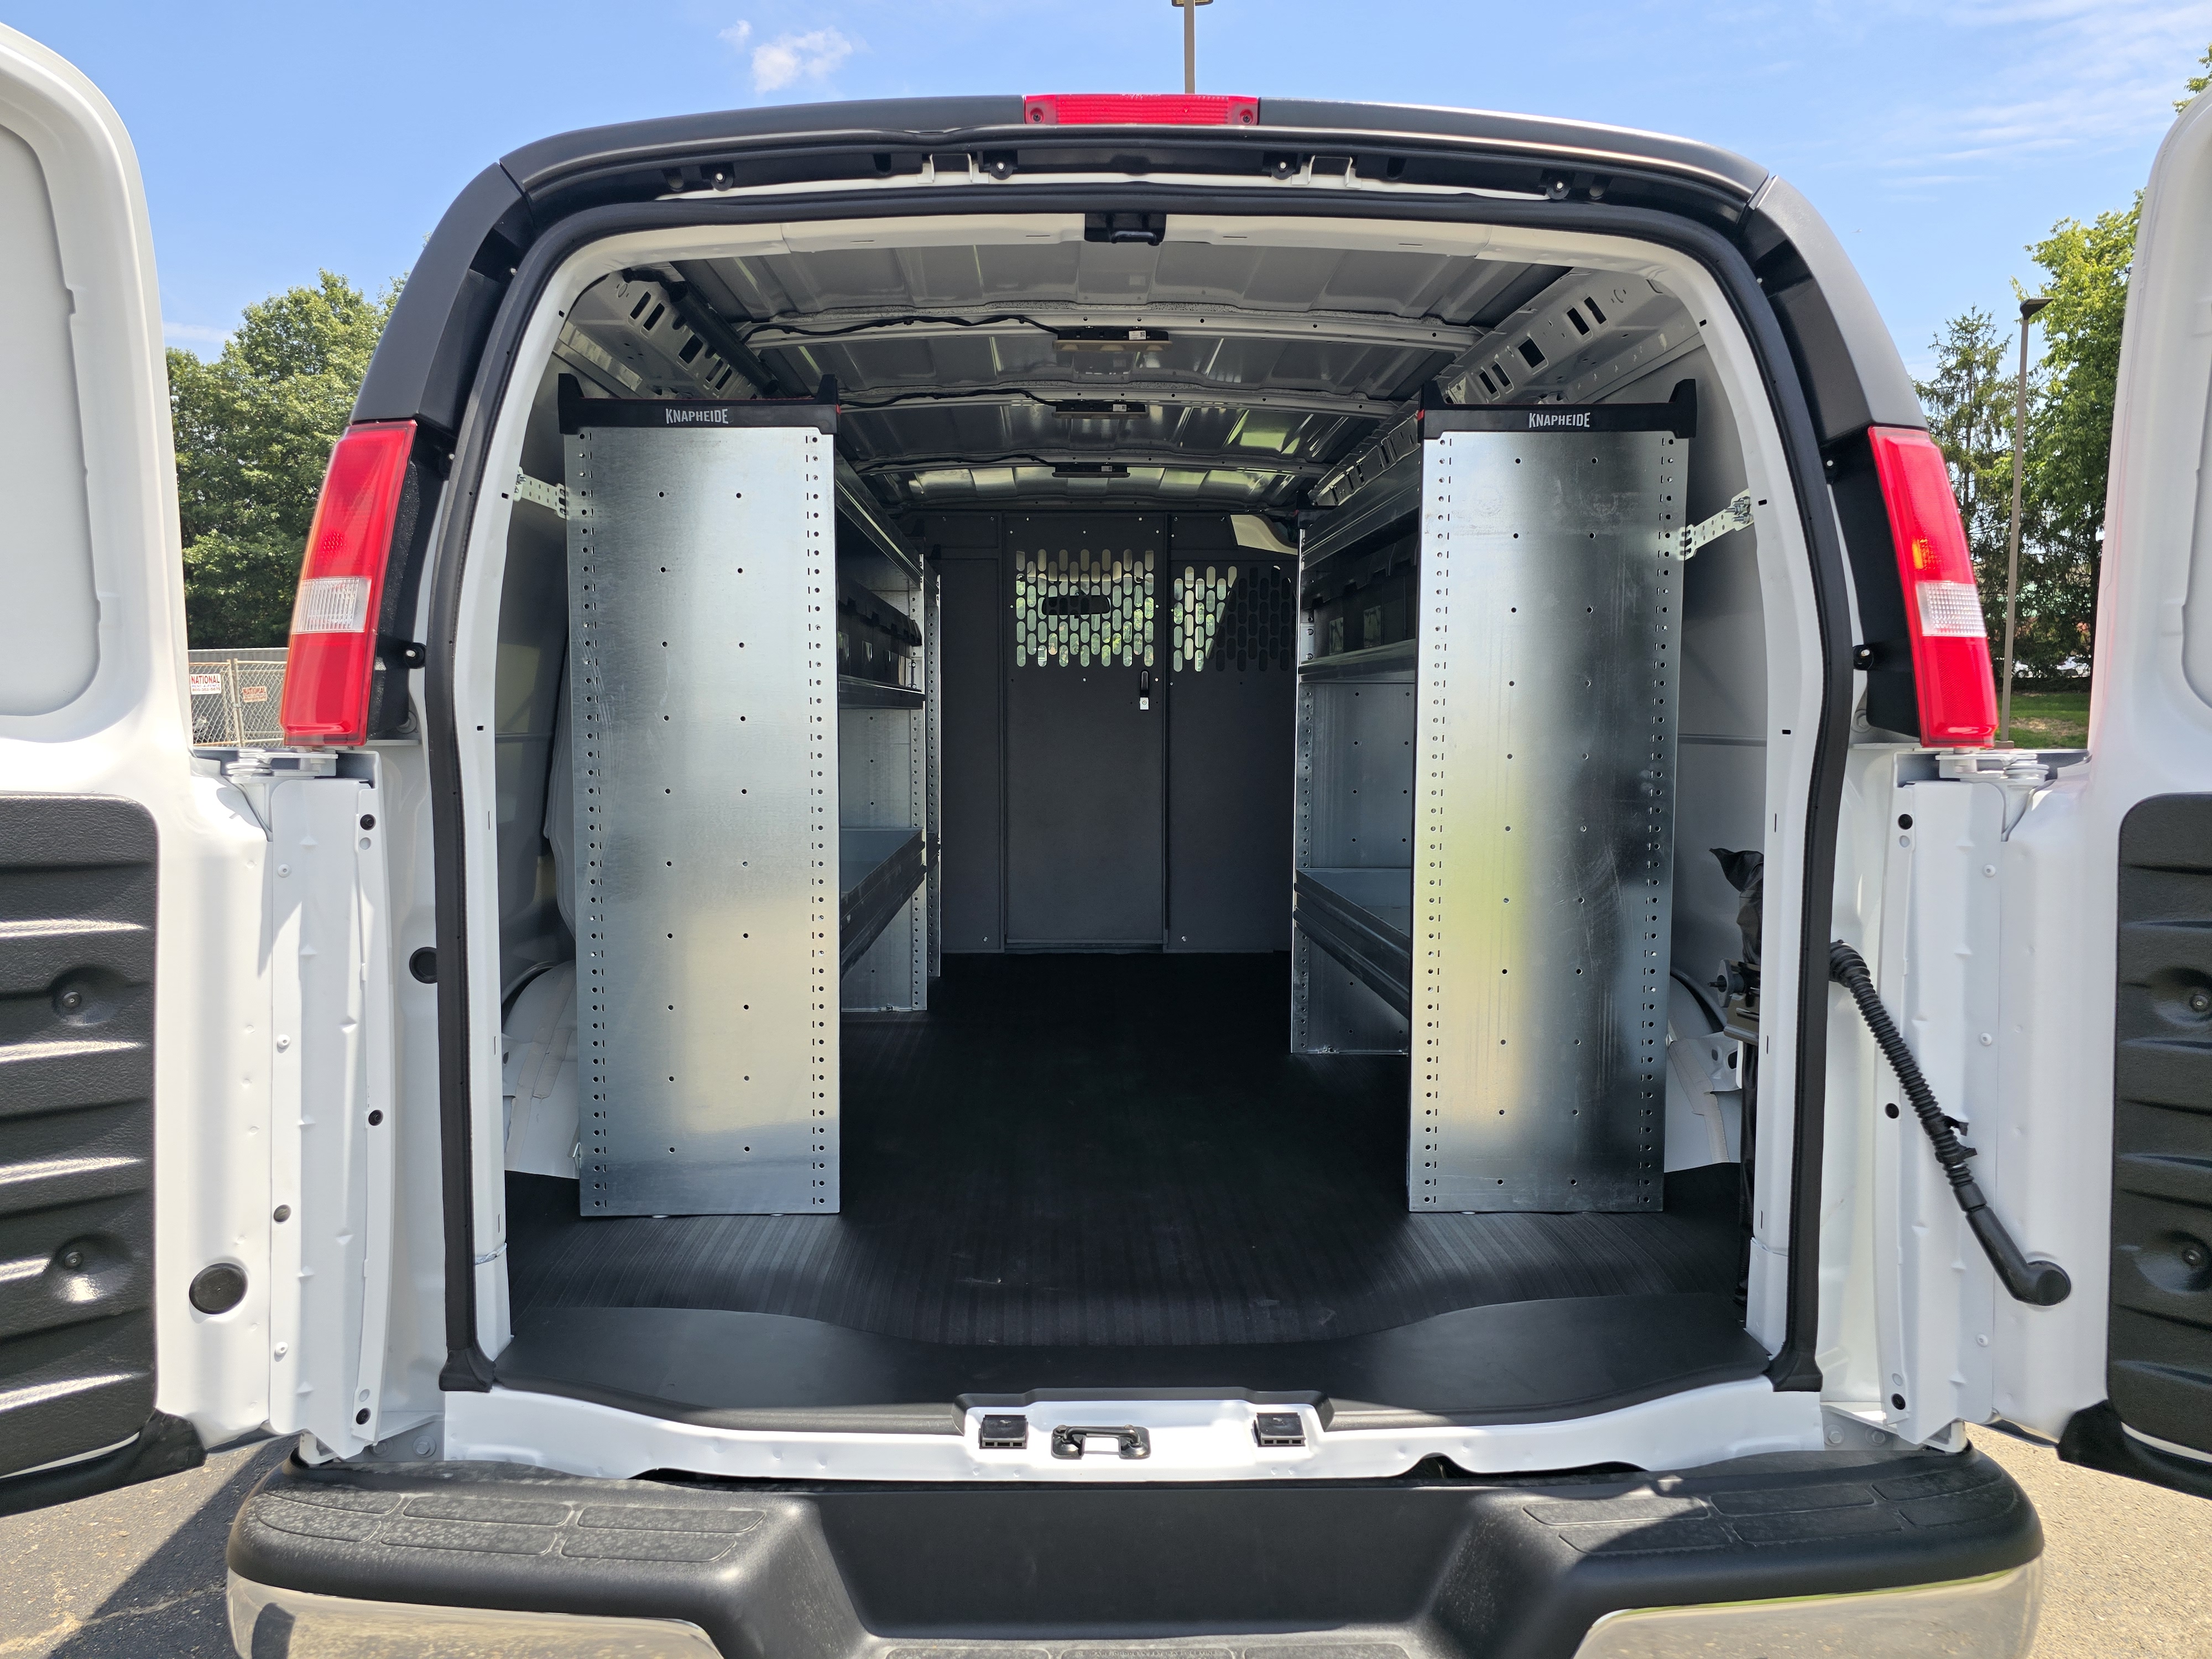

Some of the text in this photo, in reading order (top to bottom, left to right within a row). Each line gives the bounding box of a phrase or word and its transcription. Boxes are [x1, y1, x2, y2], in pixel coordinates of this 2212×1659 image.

[665, 408, 729, 424] KNAPHEIDE
[1528, 412, 1591, 429] KNAPHEIDE
[191, 675, 220, 684] NATIONAL
